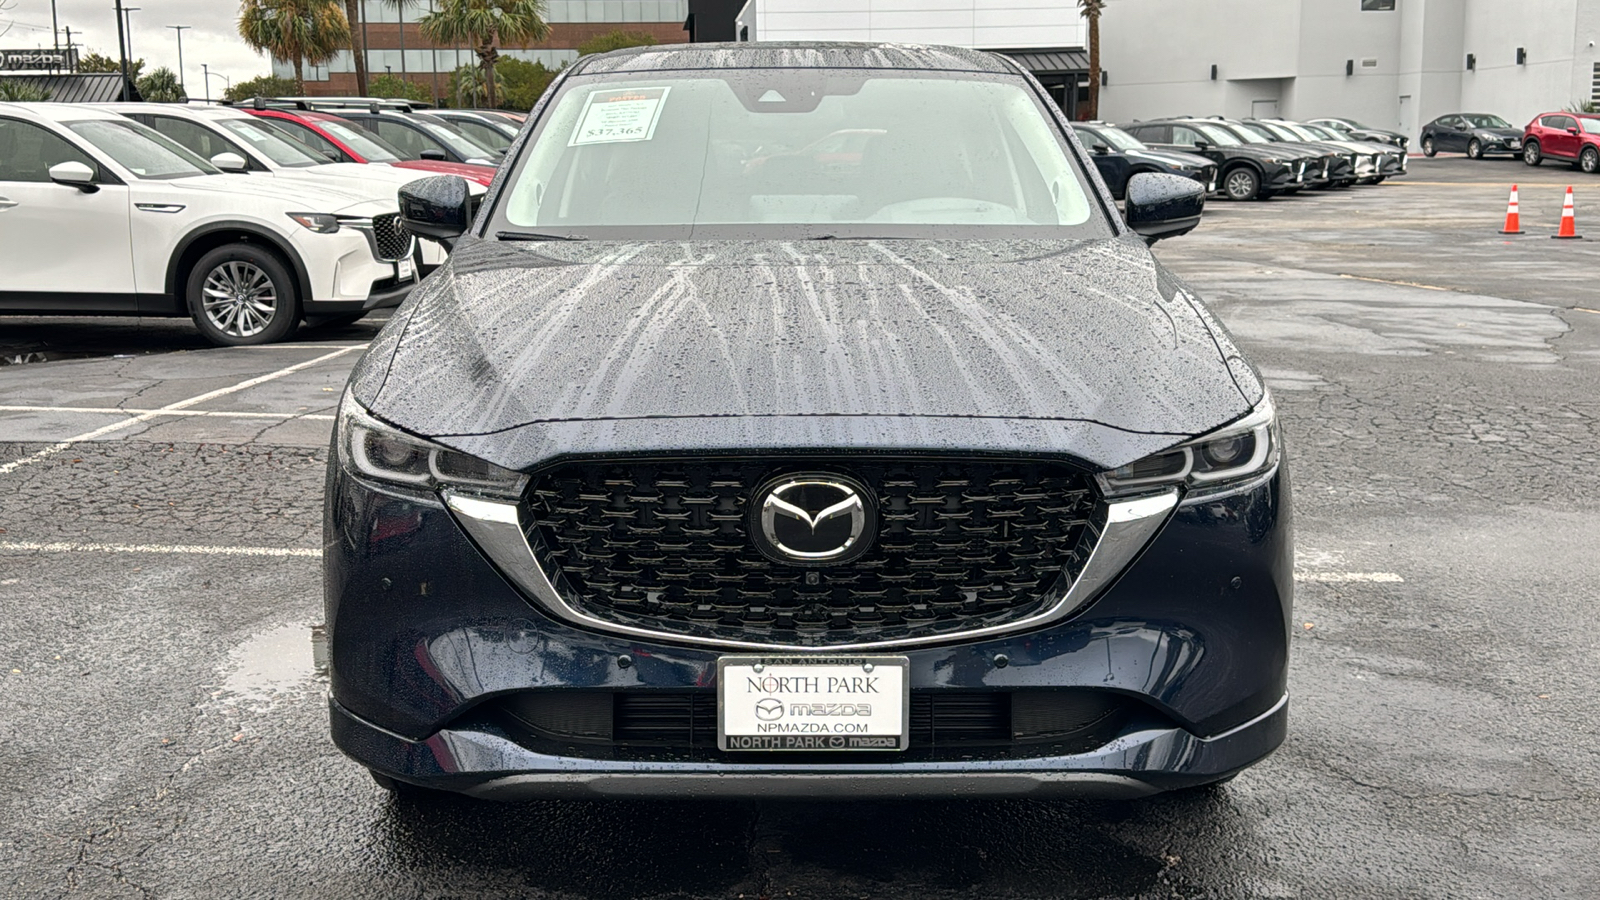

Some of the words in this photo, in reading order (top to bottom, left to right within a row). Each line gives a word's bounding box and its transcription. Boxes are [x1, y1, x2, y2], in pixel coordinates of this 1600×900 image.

[586, 126, 643, 138] $37,365
[747, 676, 819, 694] NORTH
[827, 676, 880, 694] PARK
[789, 703, 872, 717] mazda
[757, 723, 868, 733] NPMAZDA.COM
[730, 736, 781, 749] NORTH
[786, 736, 825, 748] PARK
[849, 737, 896, 747] mazda
